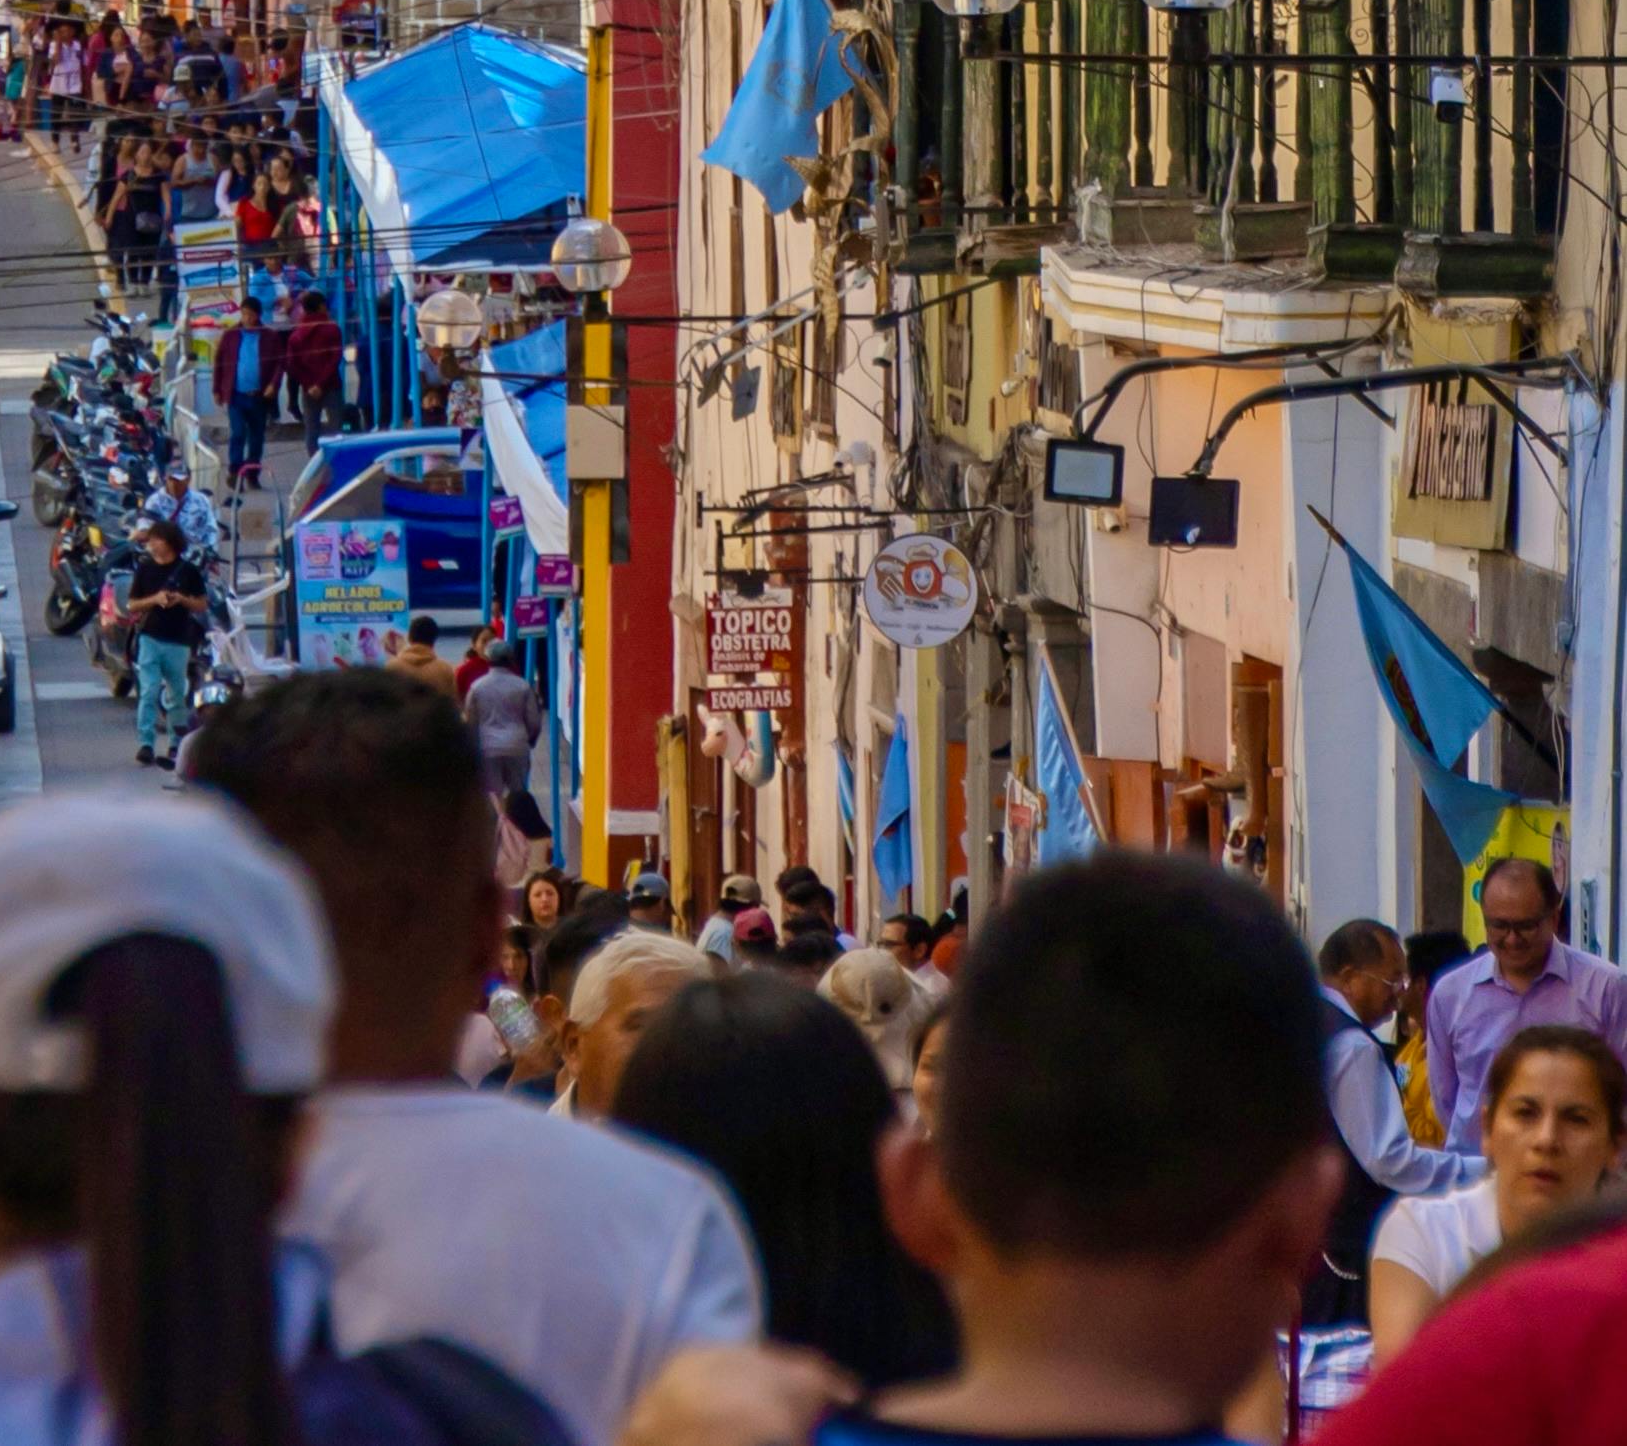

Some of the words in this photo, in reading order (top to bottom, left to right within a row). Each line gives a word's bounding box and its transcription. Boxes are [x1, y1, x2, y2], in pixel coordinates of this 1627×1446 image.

[711, 610, 792, 634] TOPICO
[711, 634, 792, 651] OBSTETRA
[711, 689, 792, 709] ECOGRAFIAS
